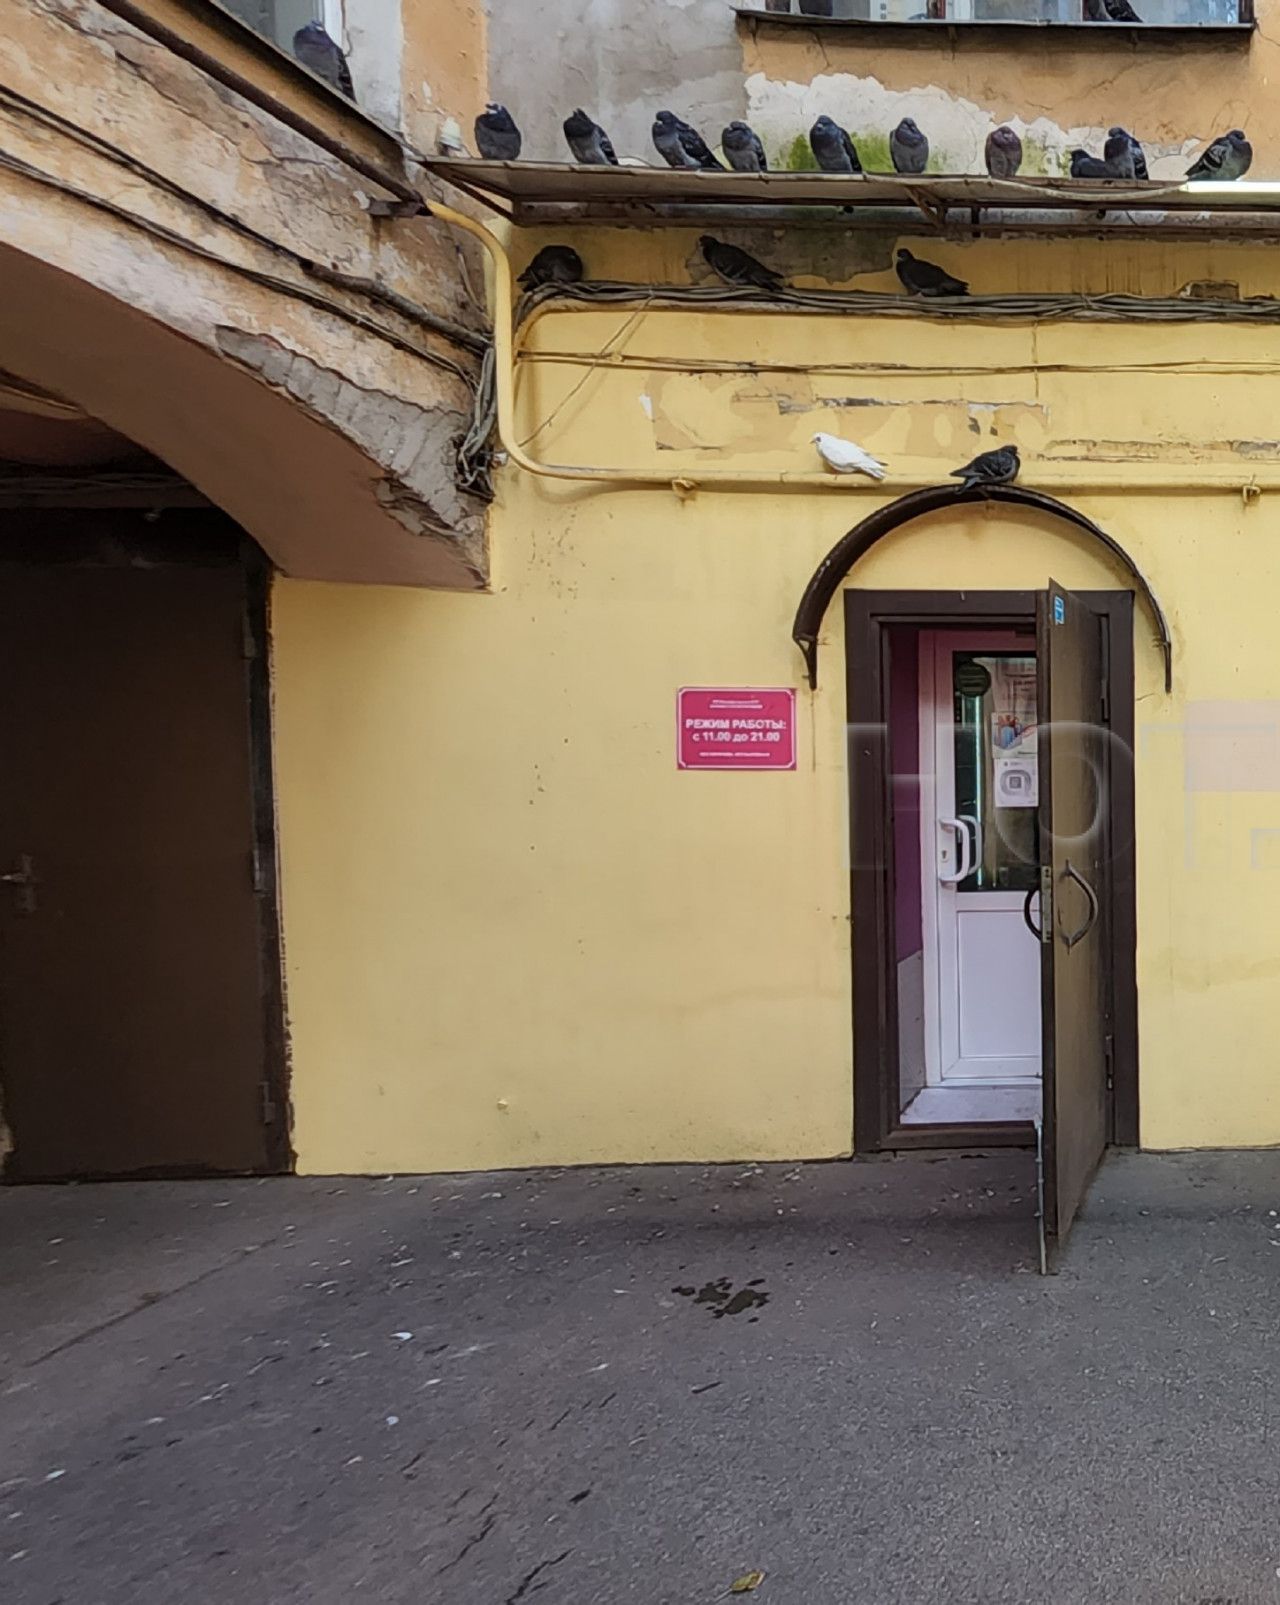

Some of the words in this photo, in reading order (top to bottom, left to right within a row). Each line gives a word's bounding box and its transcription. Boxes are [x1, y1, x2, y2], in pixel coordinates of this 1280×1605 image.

[685, 718, 730, 729] РЕЖИМ
[732, 718, 787, 730] РАБОТЫ:
[692, 732, 700, 742] с
[703, 732, 731, 742] 11.00
[732, 732, 748, 743] до
[750, 731, 780, 742] 21.00
